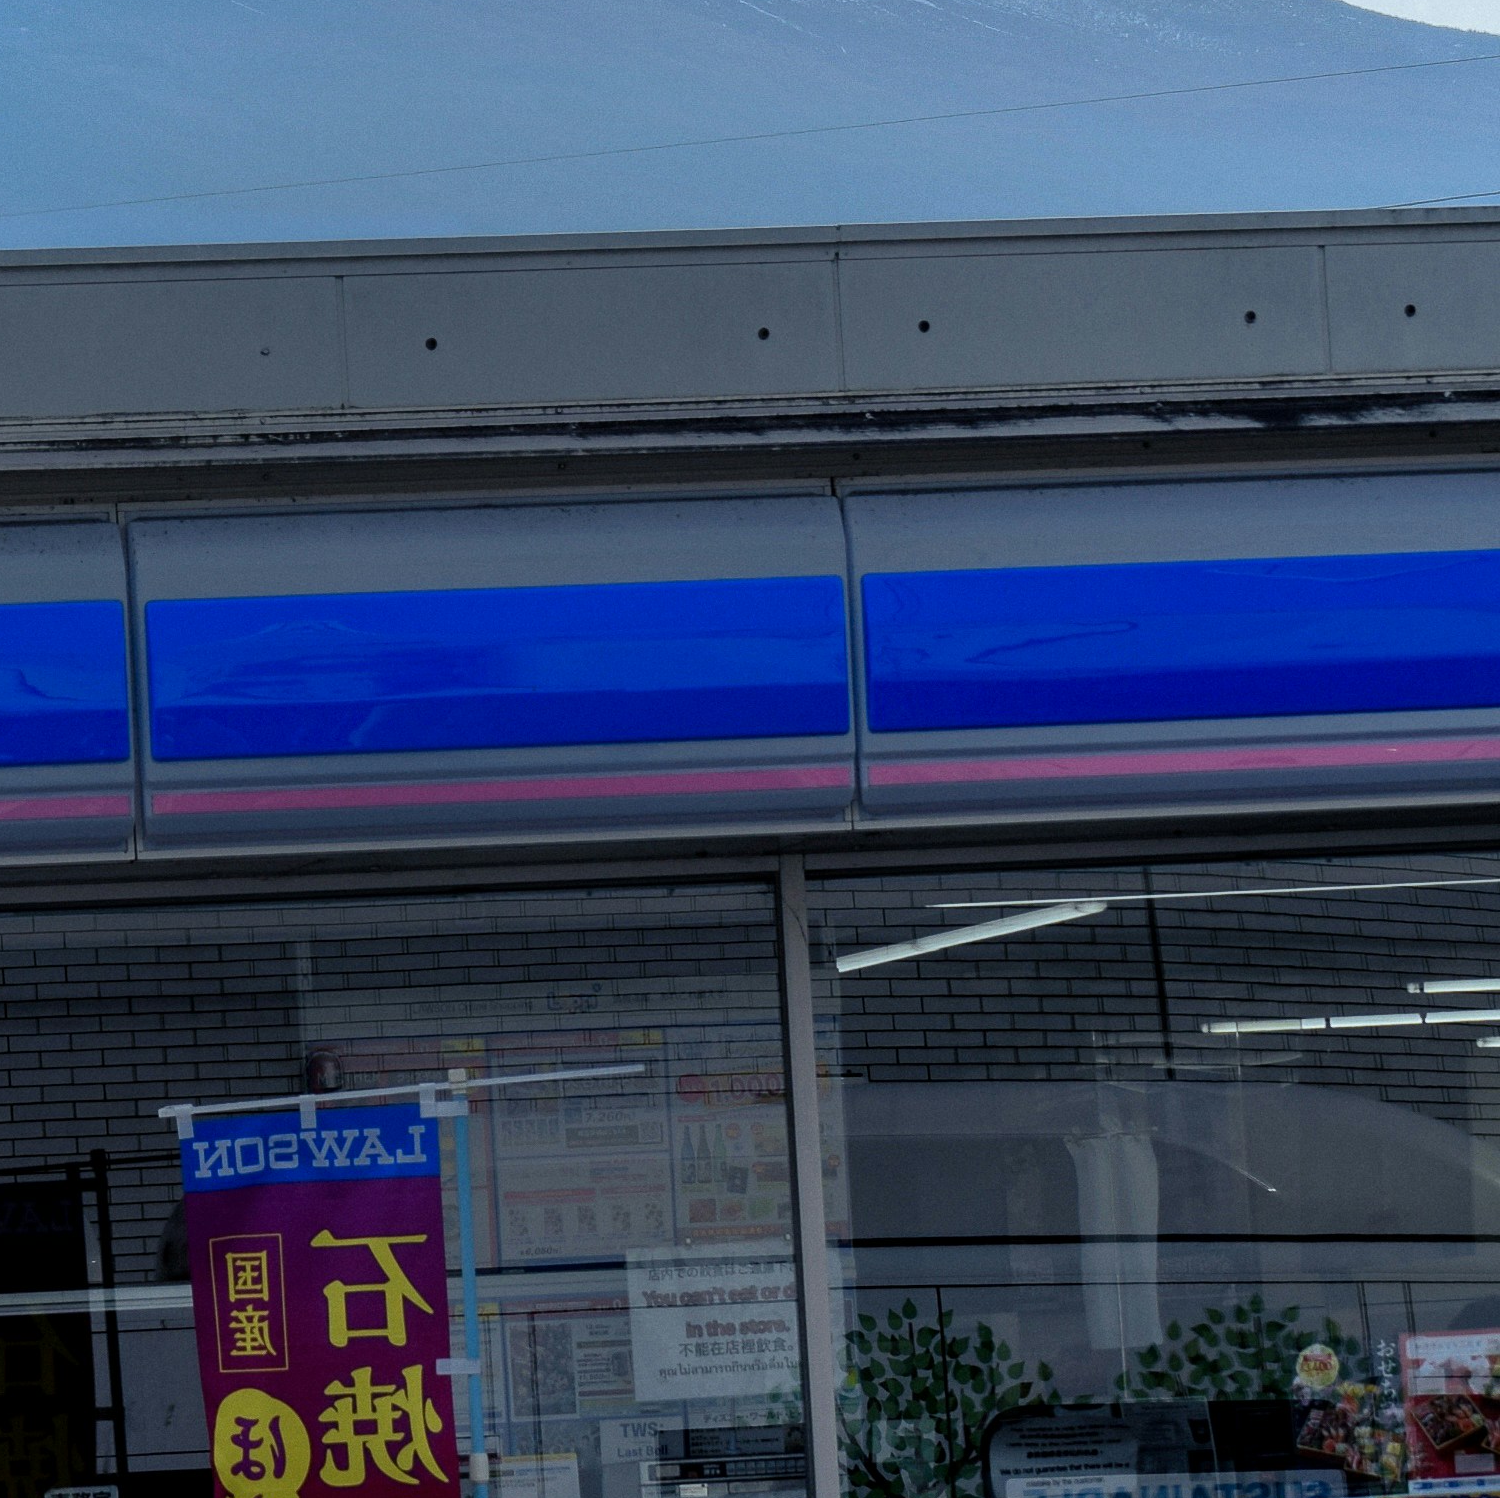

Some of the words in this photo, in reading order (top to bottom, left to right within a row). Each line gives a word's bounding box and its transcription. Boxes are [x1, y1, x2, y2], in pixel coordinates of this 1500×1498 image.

[761, 1286, 781, 1299] or
[705, 1320, 736, 1337] the
[739, 1318, 791, 1336] store.
